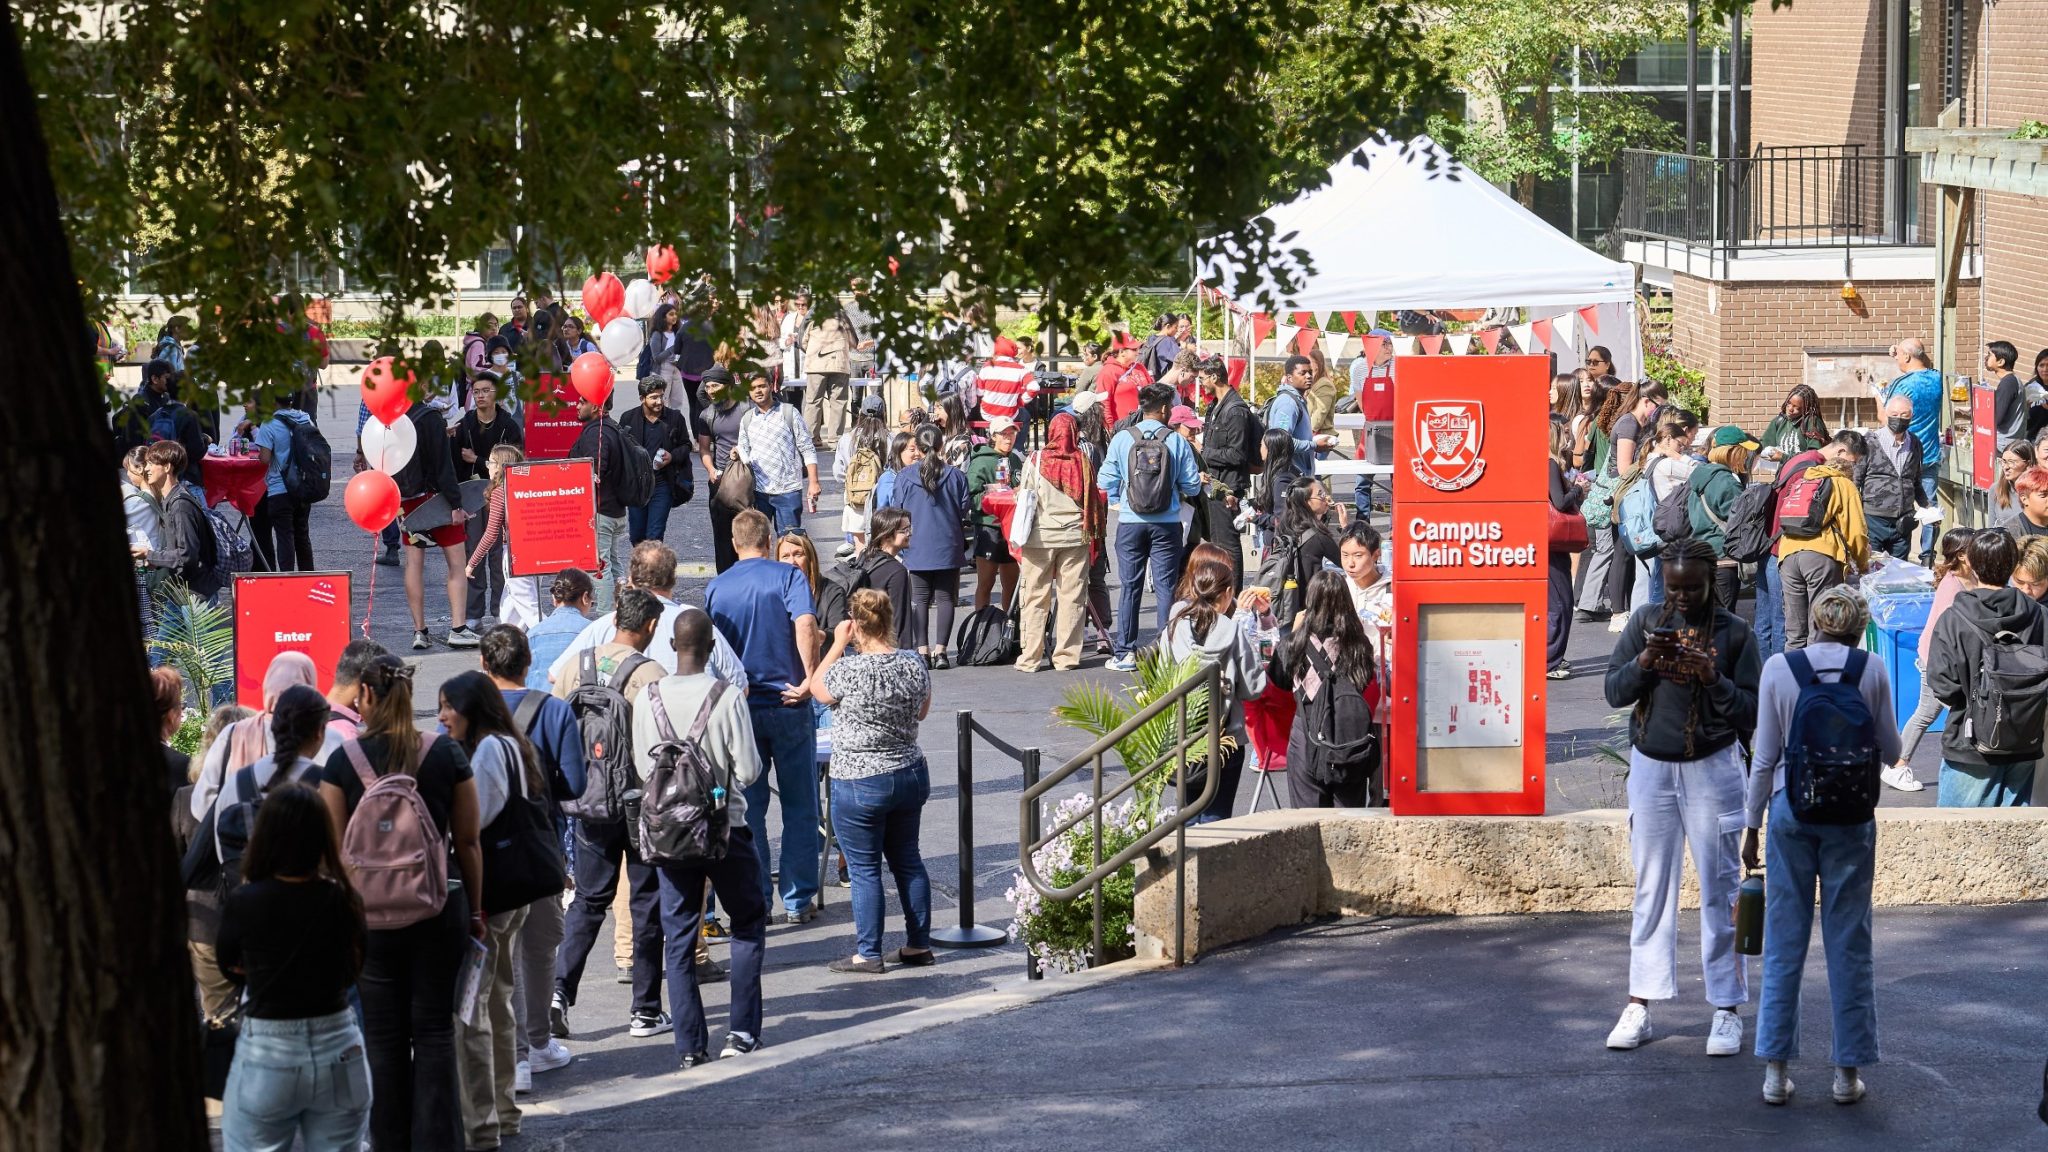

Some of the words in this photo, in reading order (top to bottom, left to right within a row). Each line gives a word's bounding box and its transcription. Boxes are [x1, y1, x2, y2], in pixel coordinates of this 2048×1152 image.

[513, 489, 557, 499] Welcome
[558, 487, 585, 496] back!
[1409, 517, 1502, 546] Campus
[1409, 544, 1462, 566] Main
[1468, 543, 1536, 566] Street
[274, 631, 312, 642] Enter
